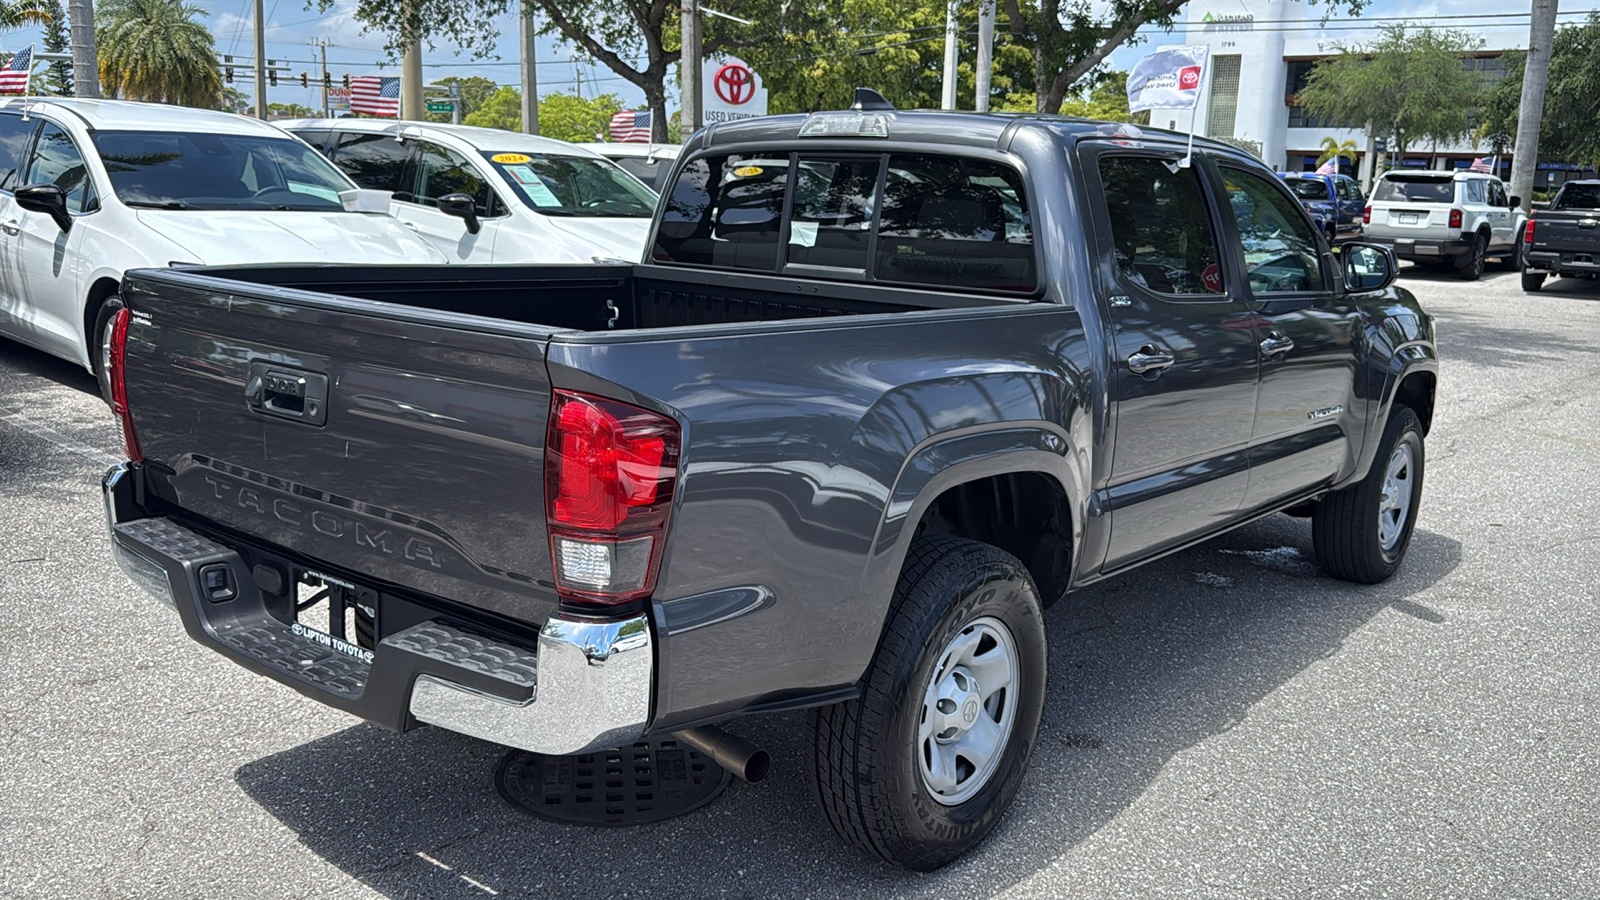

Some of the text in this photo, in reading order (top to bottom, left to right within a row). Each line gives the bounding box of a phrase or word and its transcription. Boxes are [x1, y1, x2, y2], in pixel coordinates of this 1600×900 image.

[705, 109, 726, 122] USED
[499, 155, 524, 163] 2024
[265, 376, 301, 396] TOYOTA
[205, 473, 442, 568] TACOMA
[303, 627, 364, 660] LIPTON TOYOTA
